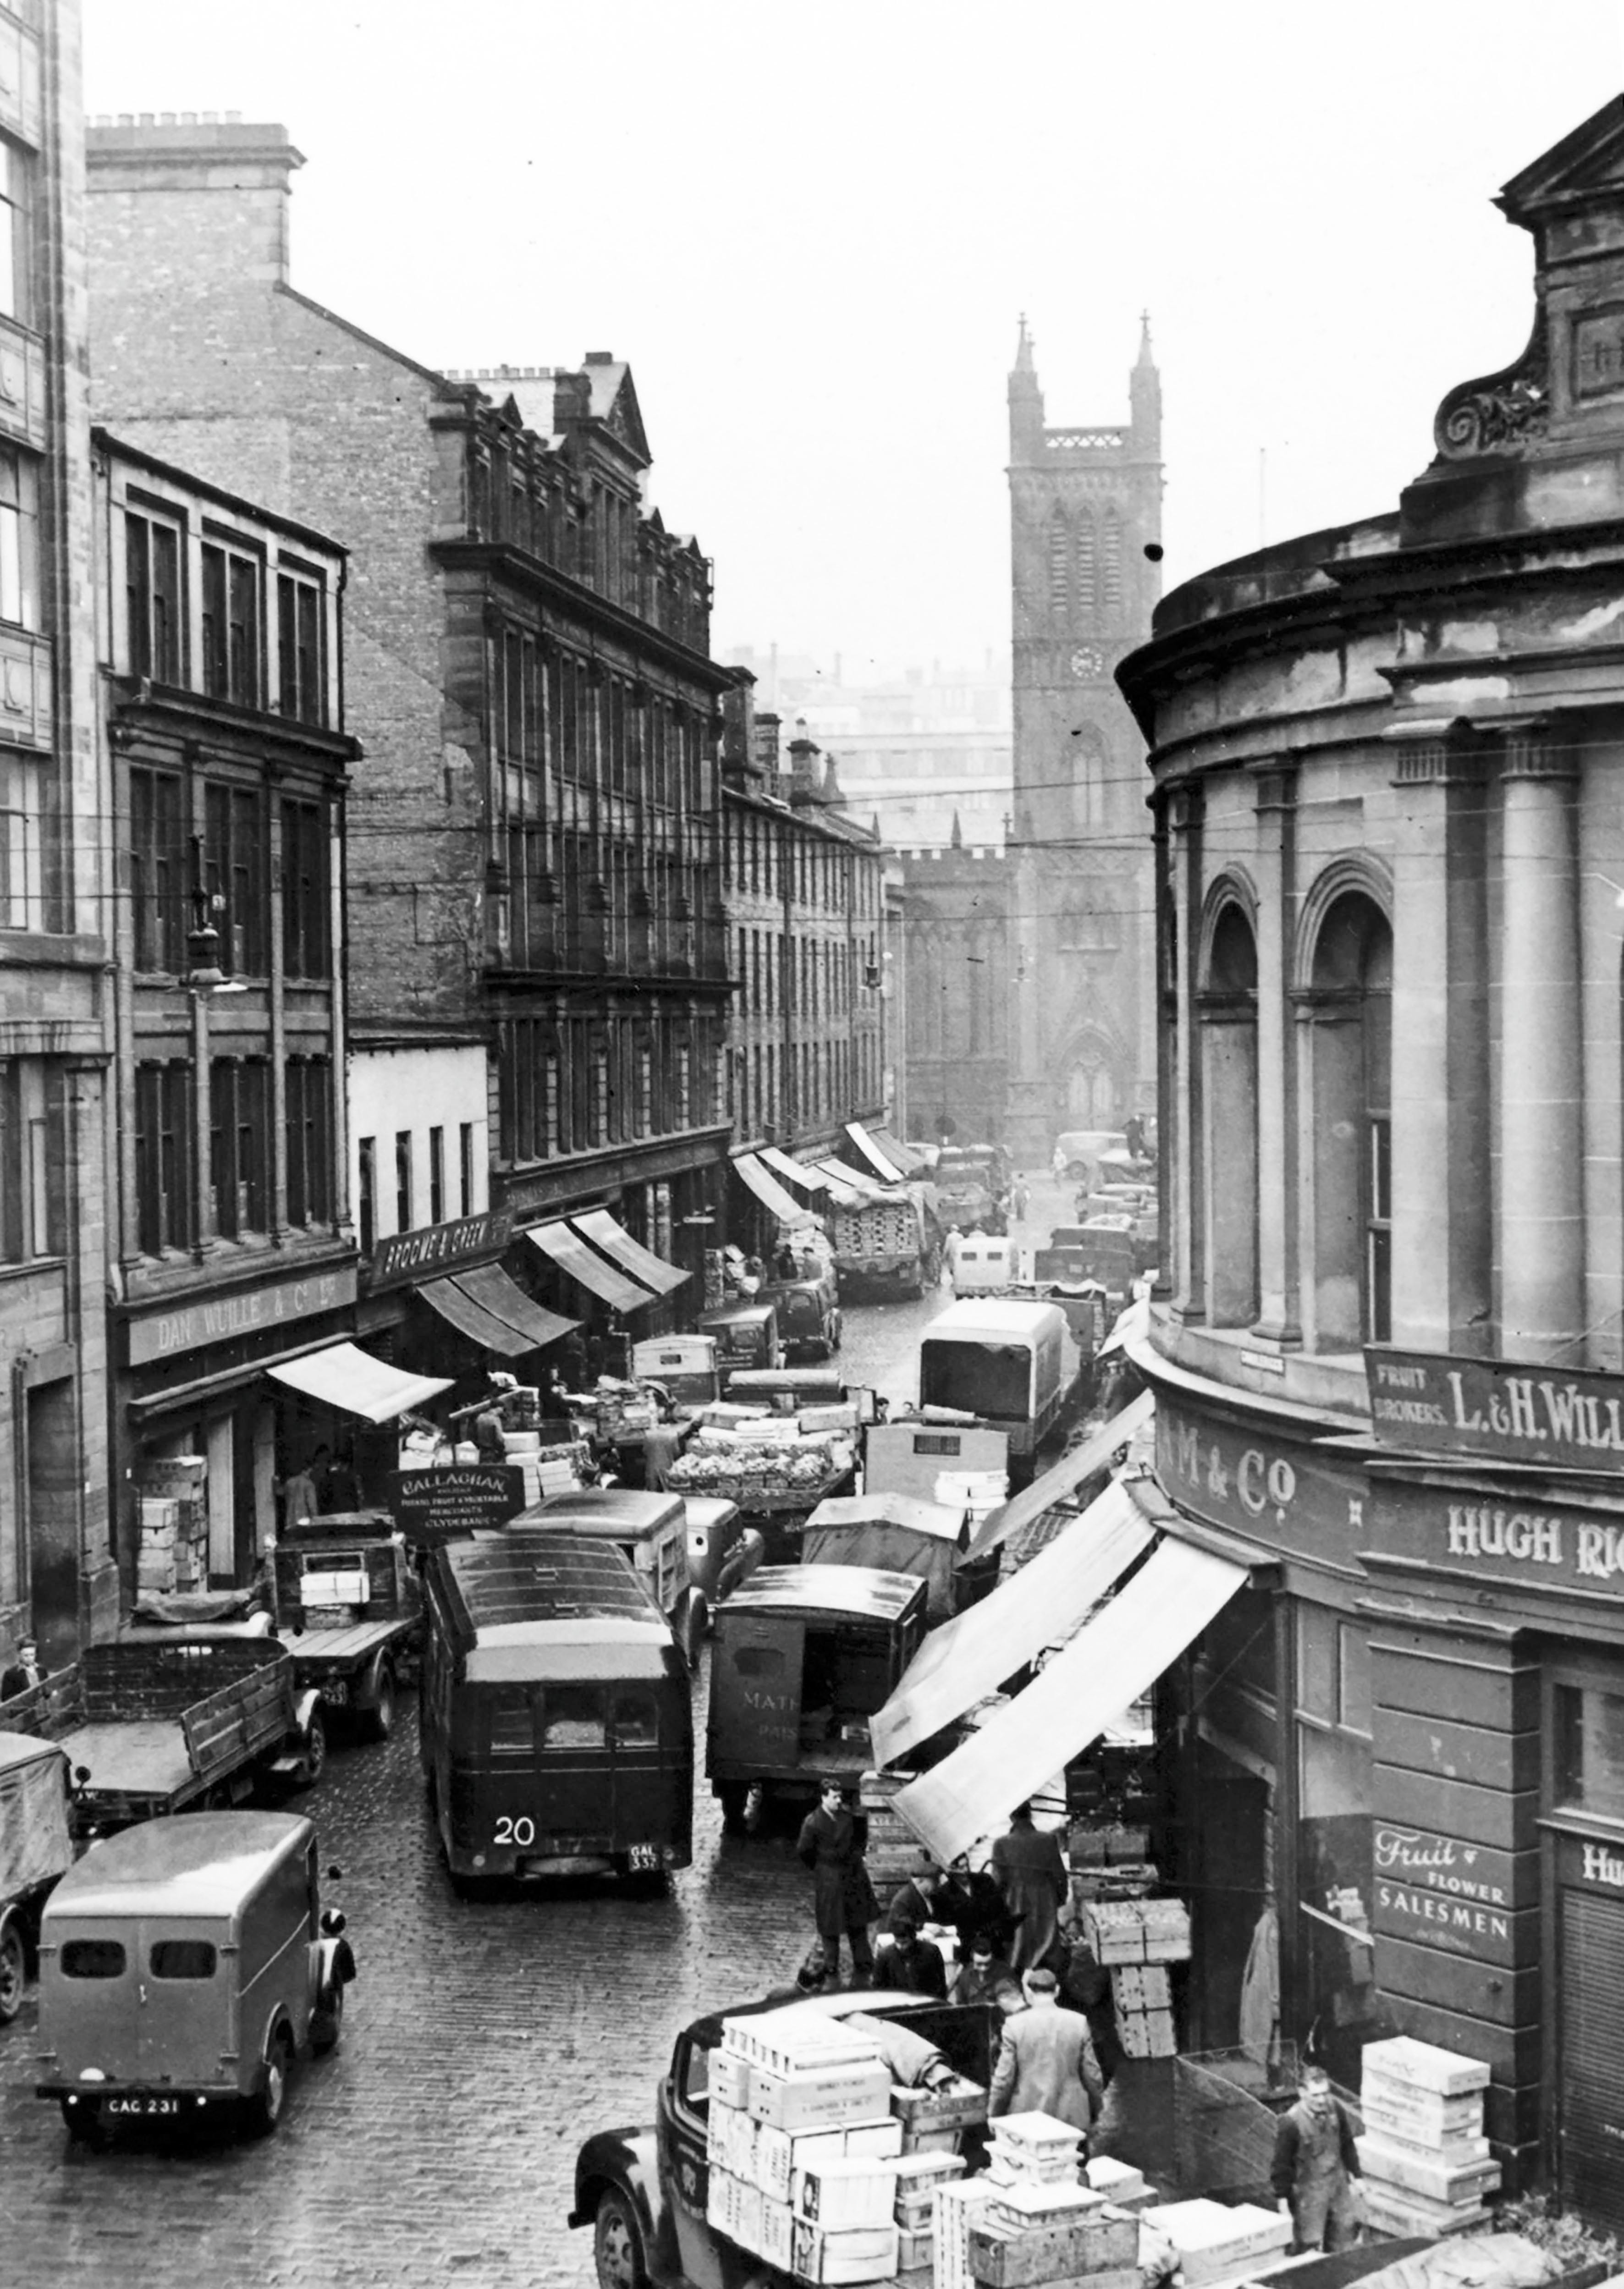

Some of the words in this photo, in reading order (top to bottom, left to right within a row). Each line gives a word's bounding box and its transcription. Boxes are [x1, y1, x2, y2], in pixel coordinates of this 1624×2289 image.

[158, 1314, 192, 1350] DAN
[1376, 1364, 1426, 1389] FRUIT
[1447, 1504, 1563, 1564] HUGH
[494, 1816, 535, 1846] 20
[631, 1845, 656, 1857] GAL
[1375, 1830, 1457, 1866] Fruit
[1428, 1871, 1506, 1904] FLOWER
[1379, 1886, 1508, 1938] SALESMEN
[147, 2099, 178, 2113] 231
